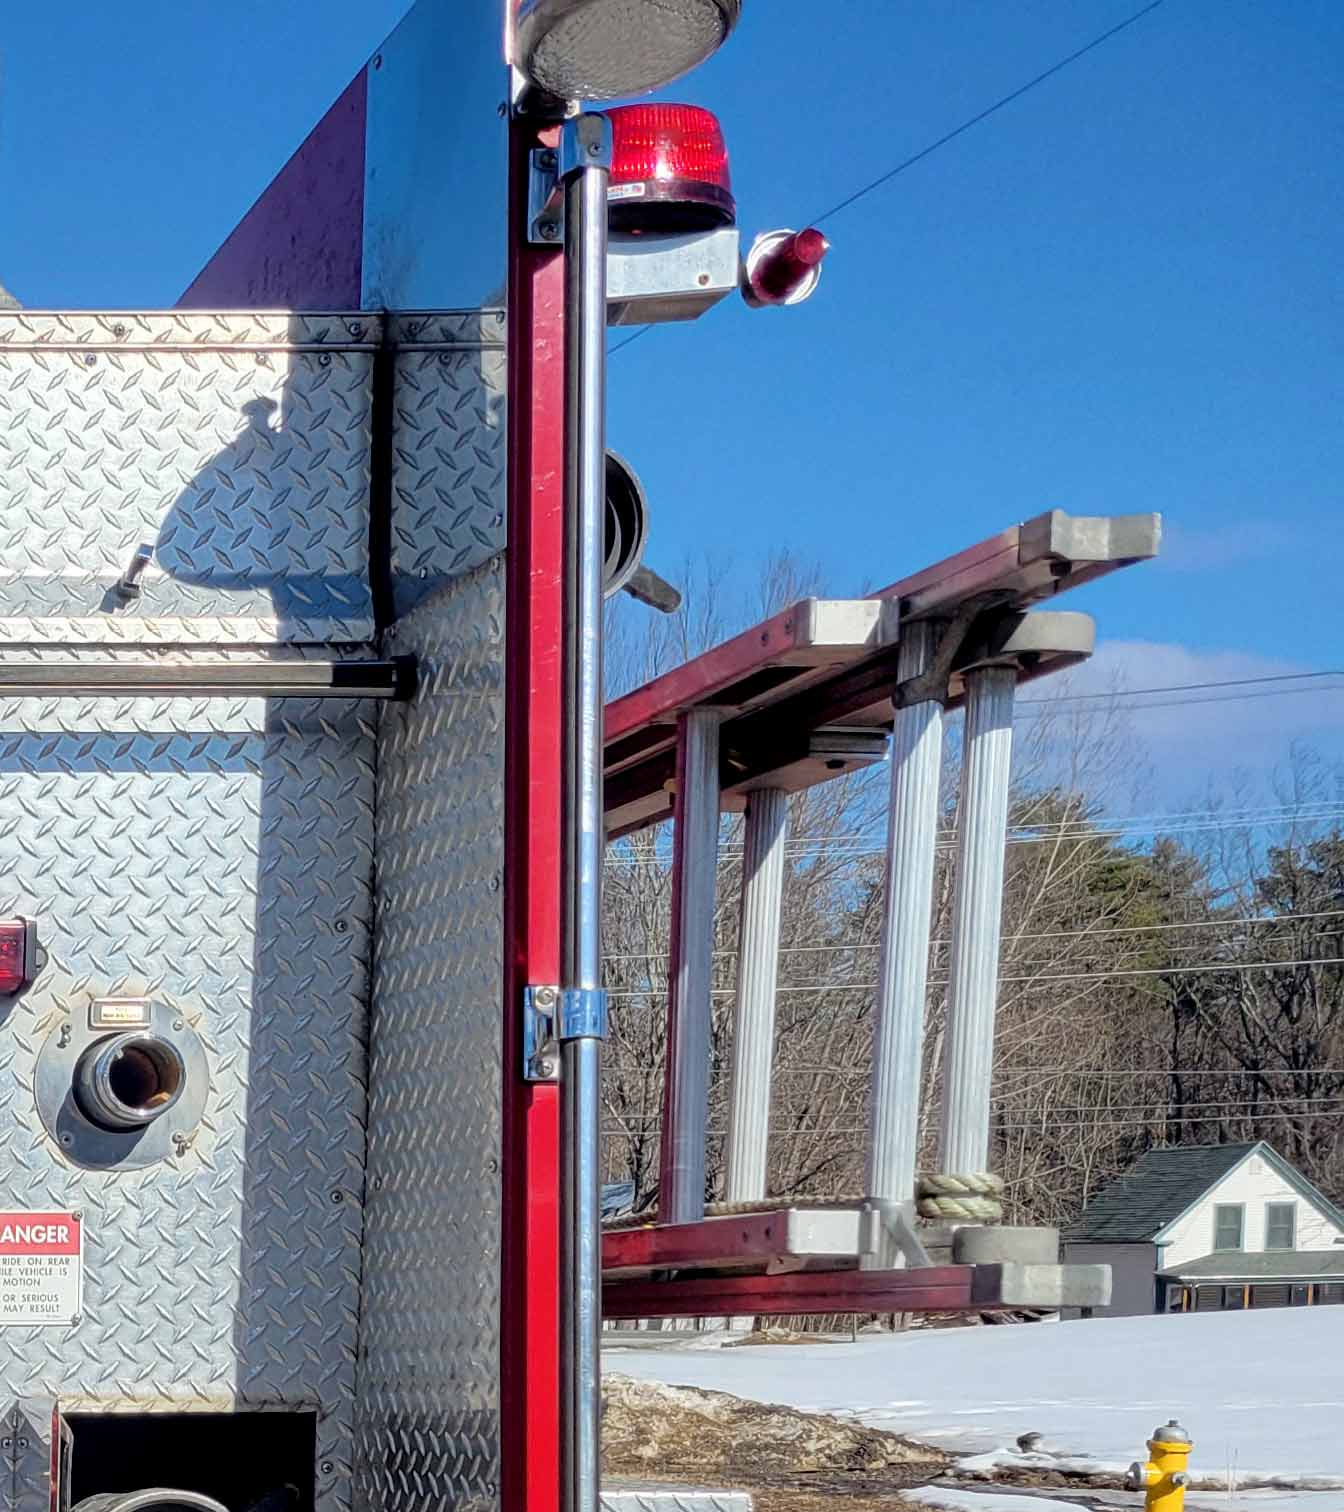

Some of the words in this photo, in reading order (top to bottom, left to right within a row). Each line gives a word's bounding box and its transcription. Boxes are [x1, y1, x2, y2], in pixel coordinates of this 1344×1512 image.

[2, 1257, 21, 1266] RIDE
[27, 1257, 42, 1266] ON
[48, 1257, 70, 1266] REAR
[18, 1267, 53, 1277] VEHICLE
[59, 1267, 68, 1276] IS
[3, 1278, 41, 1287] MOTION
[2, 1294, 16, 1303] OR
[22, 1294, 59, 1303] SERIOUS
[3, 1304, 24, 1313] MAY
[30, 1304, 60, 1313] RESULT
